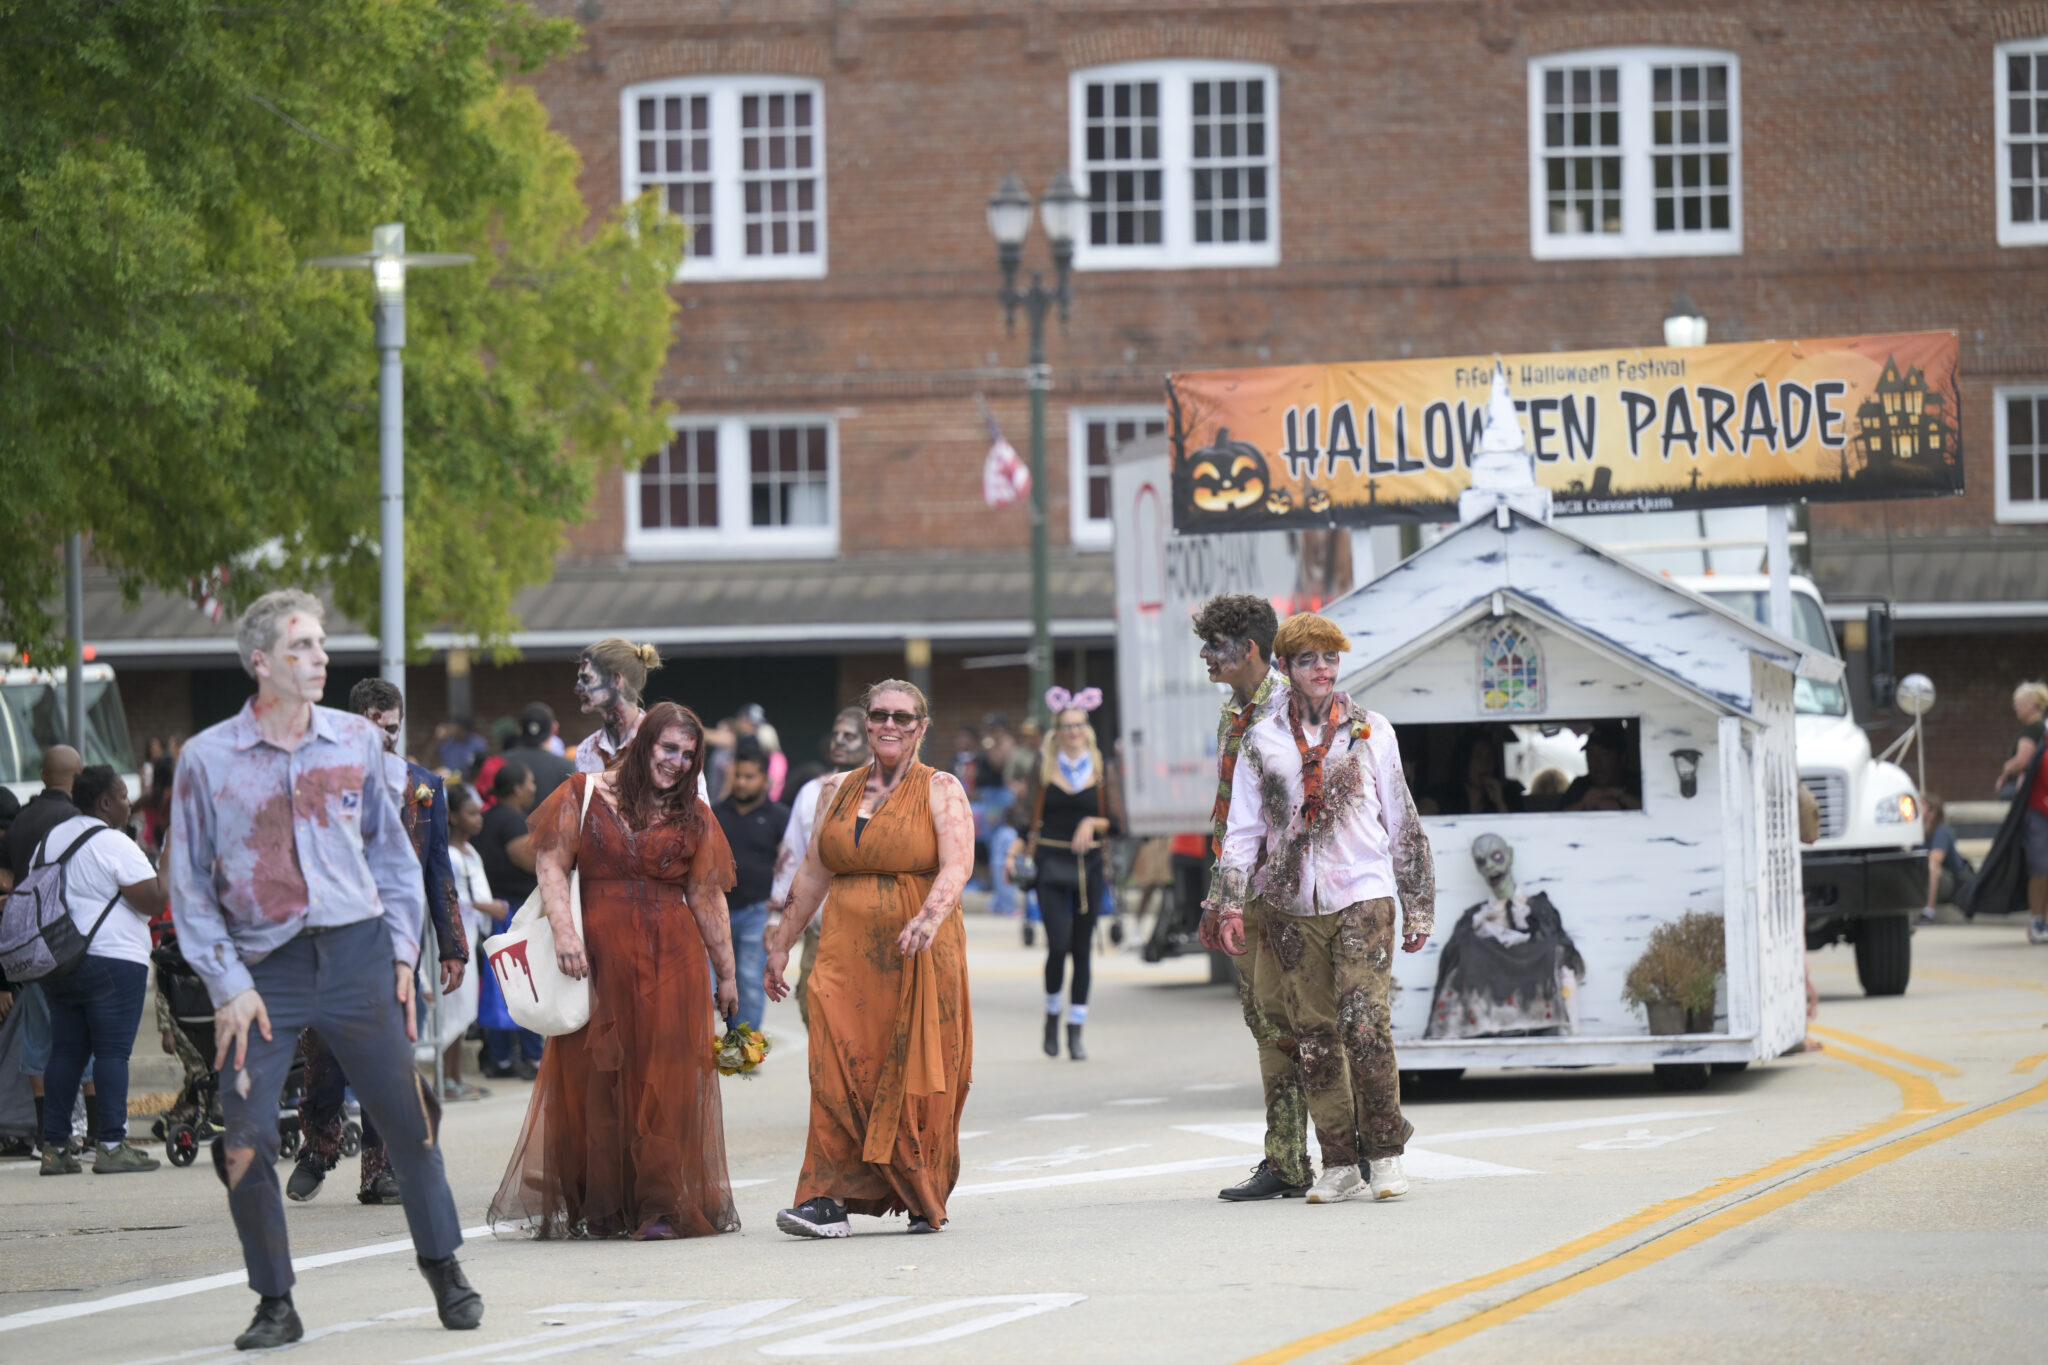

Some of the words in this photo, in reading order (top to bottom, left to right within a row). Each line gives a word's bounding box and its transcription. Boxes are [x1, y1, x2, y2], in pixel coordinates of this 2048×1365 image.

[1521, 363, 1610, 386] Halloween
[1616, 358, 1686, 382] Festival
[1618, 380, 1847, 460] PARADE
